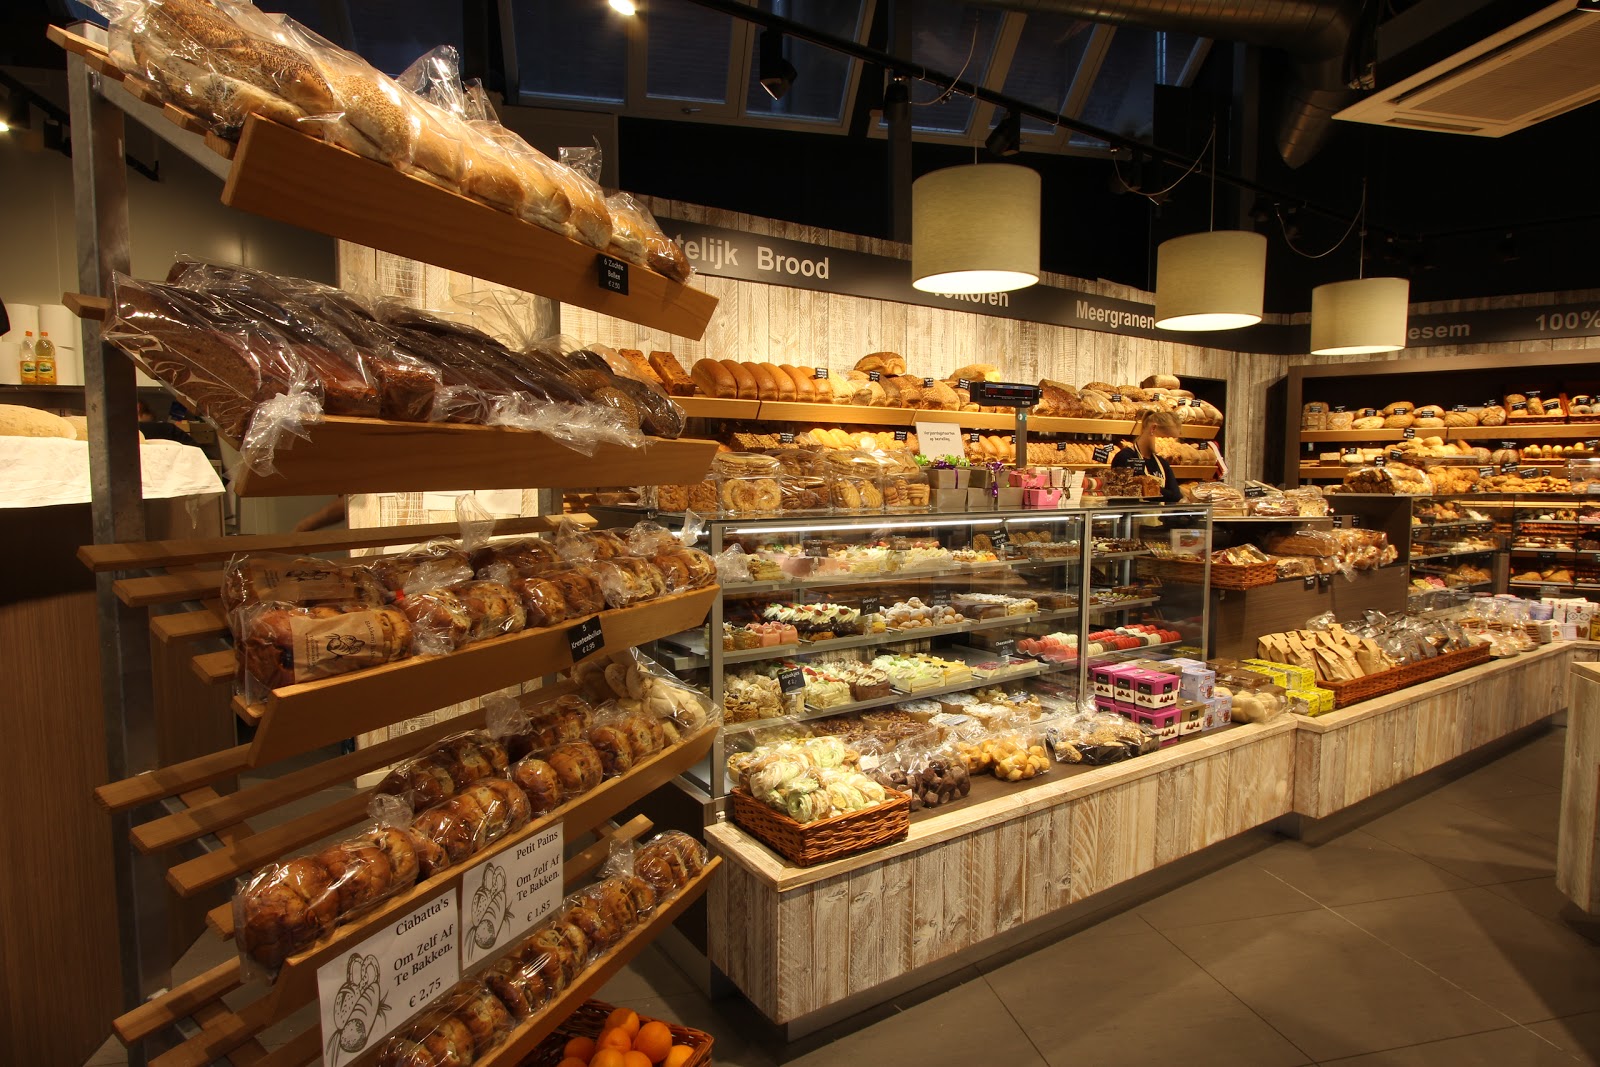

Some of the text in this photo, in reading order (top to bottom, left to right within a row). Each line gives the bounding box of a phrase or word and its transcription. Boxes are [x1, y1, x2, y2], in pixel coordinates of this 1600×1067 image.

[757, 246, 829, 279] Brood
[1076, 300, 1155, 330] Meergranen
[516, 831, 559, 860] Petit Pains
[516, 853, 560, 888] Om Zelf Af
[516, 870, 560, 901] Te Bakken.
[395, 898, 449, 936] Ciabatta's
[526, 899, 551, 922] € 1,85
[394, 923, 454, 971] Om Zelf Af
[394, 943, 453, 987] Te Bakken.
[409, 977, 442, 1008] € 2,75
